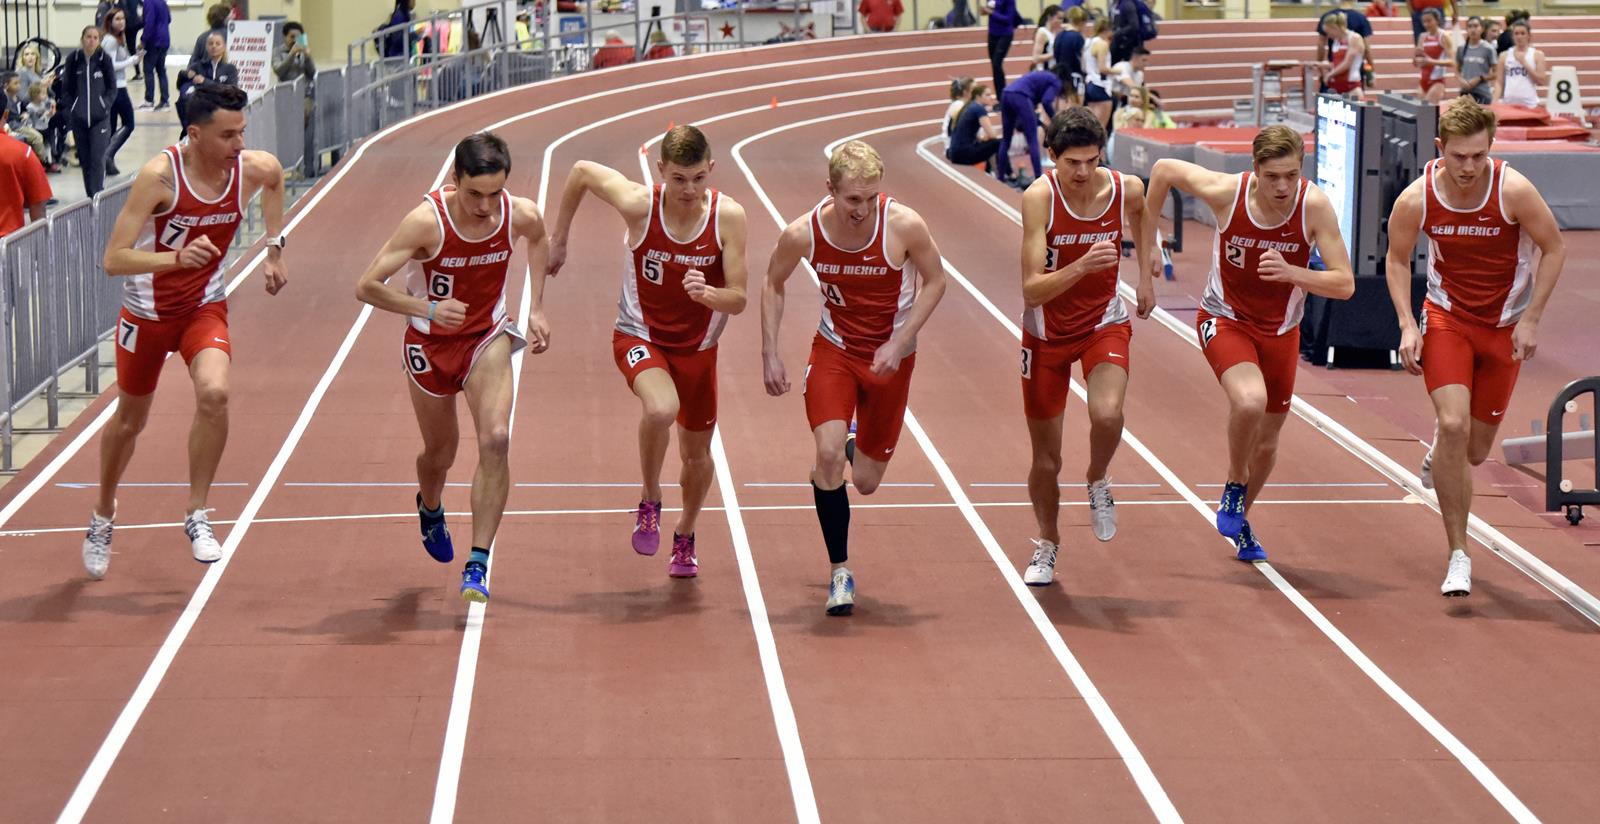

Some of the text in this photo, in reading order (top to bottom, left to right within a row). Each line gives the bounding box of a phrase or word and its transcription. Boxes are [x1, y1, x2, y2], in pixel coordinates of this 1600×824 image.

[1556, 80, 1572, 104] 8
[200, 212, 238, 226] MEXICO
[166, 223, 185, 246] 7
[1052, 231, 1119, 246] NEW MEXICO
[1431, 225, 1501, 236] NEW MEXICO
[1230, 235, 1300, 252] NEW MEXICO
[440, 250, 509, 268] NEW MEXICO
[647, 249, 716, 266] NEW MEXICO
[1227, 245, 1242, 266] 2
[644, 259, 659, 281] 5
[815, 262, 887, 275] NEW MEXICO
[432, 274, 449, 296] 6
[826, 284, 841, 304] 4
[121, 321, 134, 346] 7
[1202, 320, 1213, 344] 2
[408, 346, 427, 372] 6
[629, 346, 646, 364] 5
[1021, 349, 1029, 375] 3
